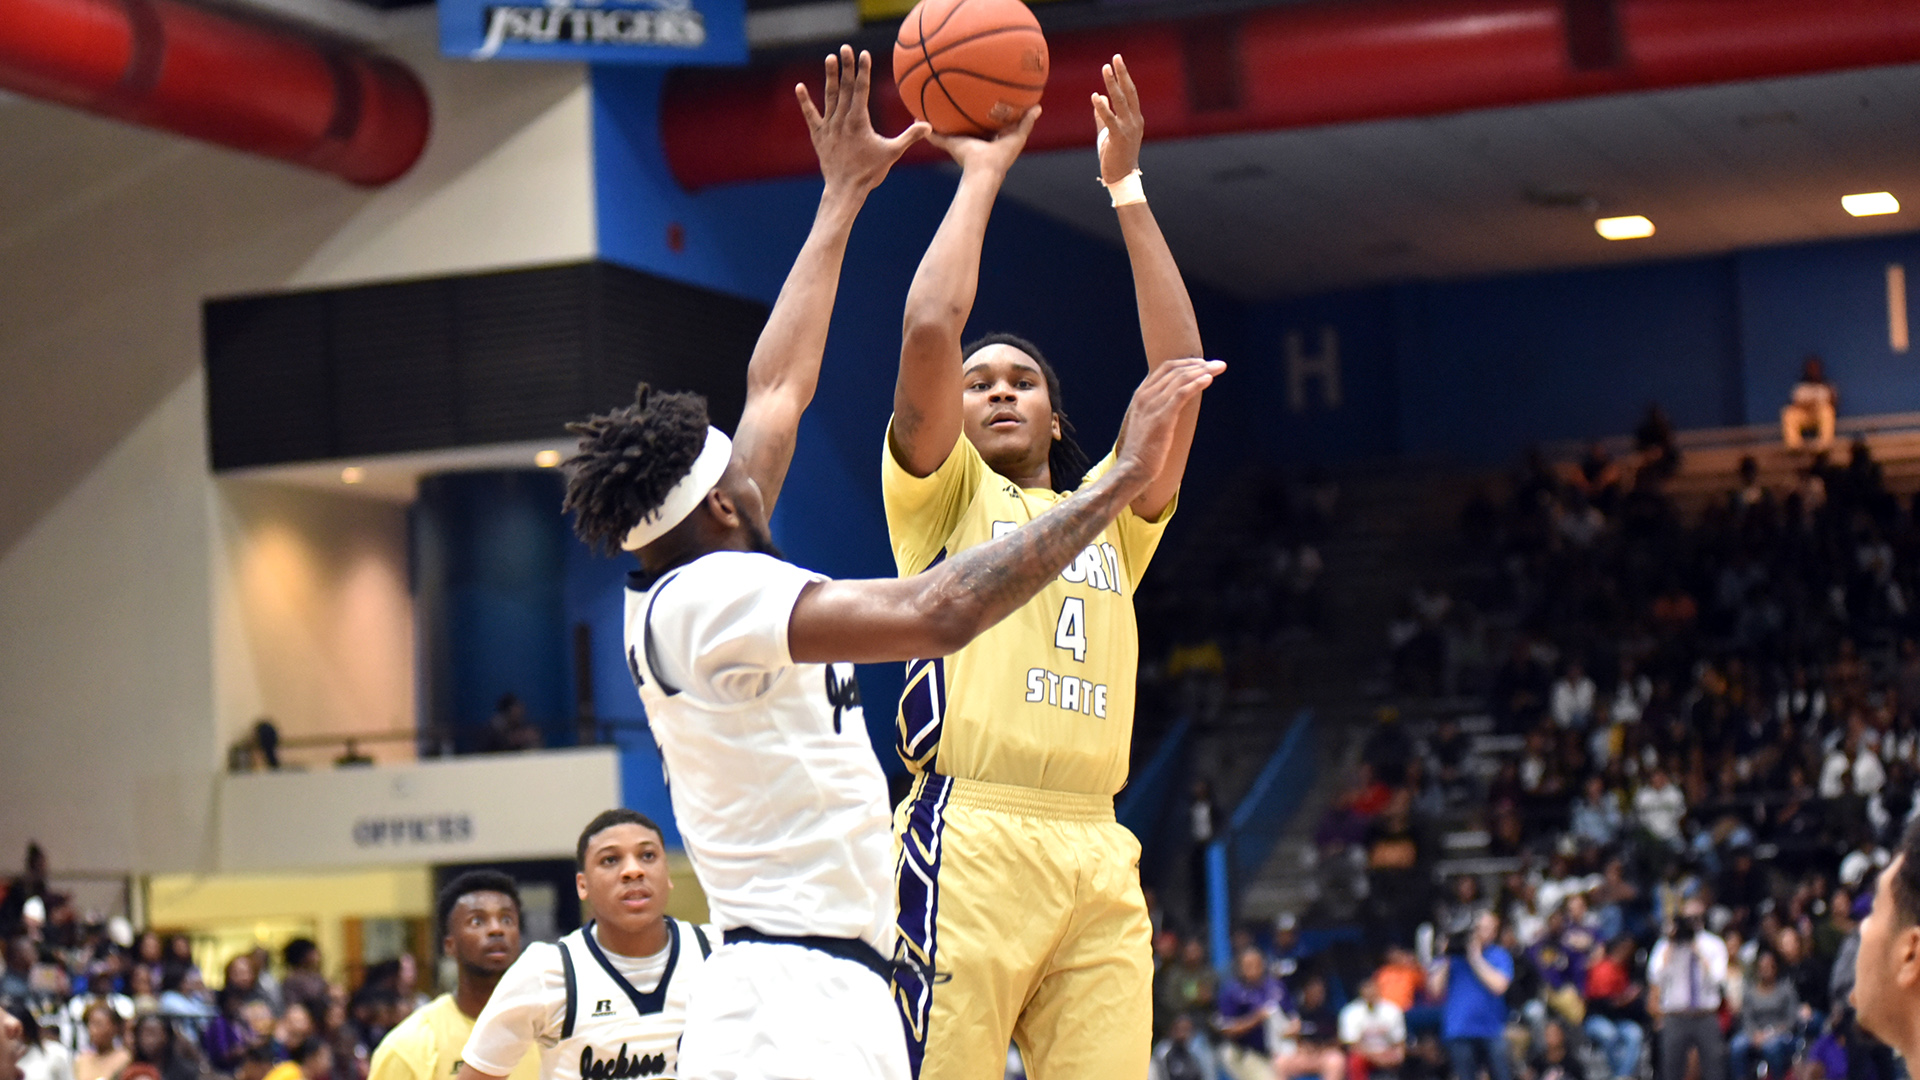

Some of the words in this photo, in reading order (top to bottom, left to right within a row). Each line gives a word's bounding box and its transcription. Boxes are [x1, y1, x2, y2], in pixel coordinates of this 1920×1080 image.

[1284, 325, 1342, 411] H
[1055, 596, 1087, 663] 4
[1025, 668, 1108, 720] STATE
[352, 815, 473, 847] OFFICES
